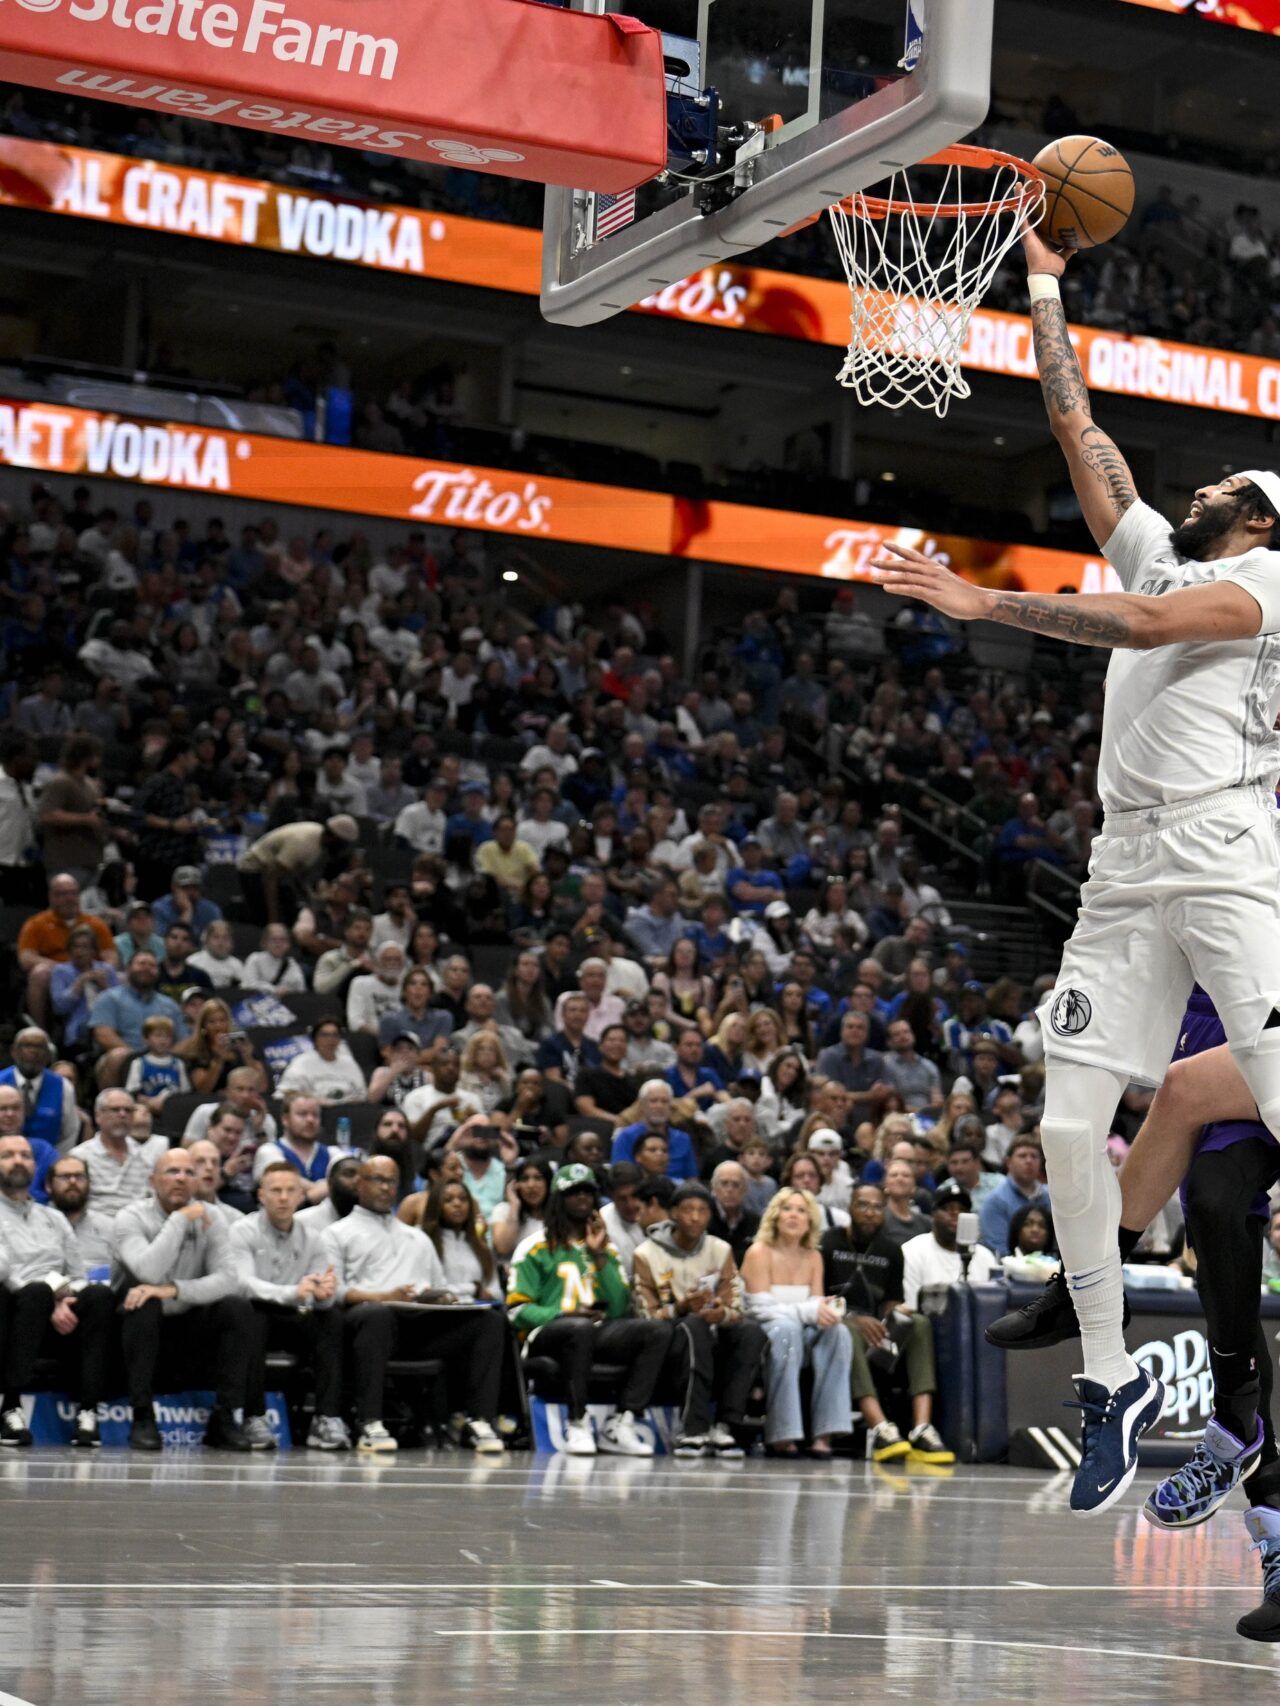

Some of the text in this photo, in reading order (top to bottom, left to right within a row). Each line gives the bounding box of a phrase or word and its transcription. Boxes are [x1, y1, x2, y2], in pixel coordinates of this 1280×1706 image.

[122, 166, 268, 243] CRAFT
[277, 194, 425, 272] VODKA
[1088, 337, 1250, 411] ORIGINAL
[84, 417, 231, 490] VODKA
[410, 469, 552, 532] Tito's
